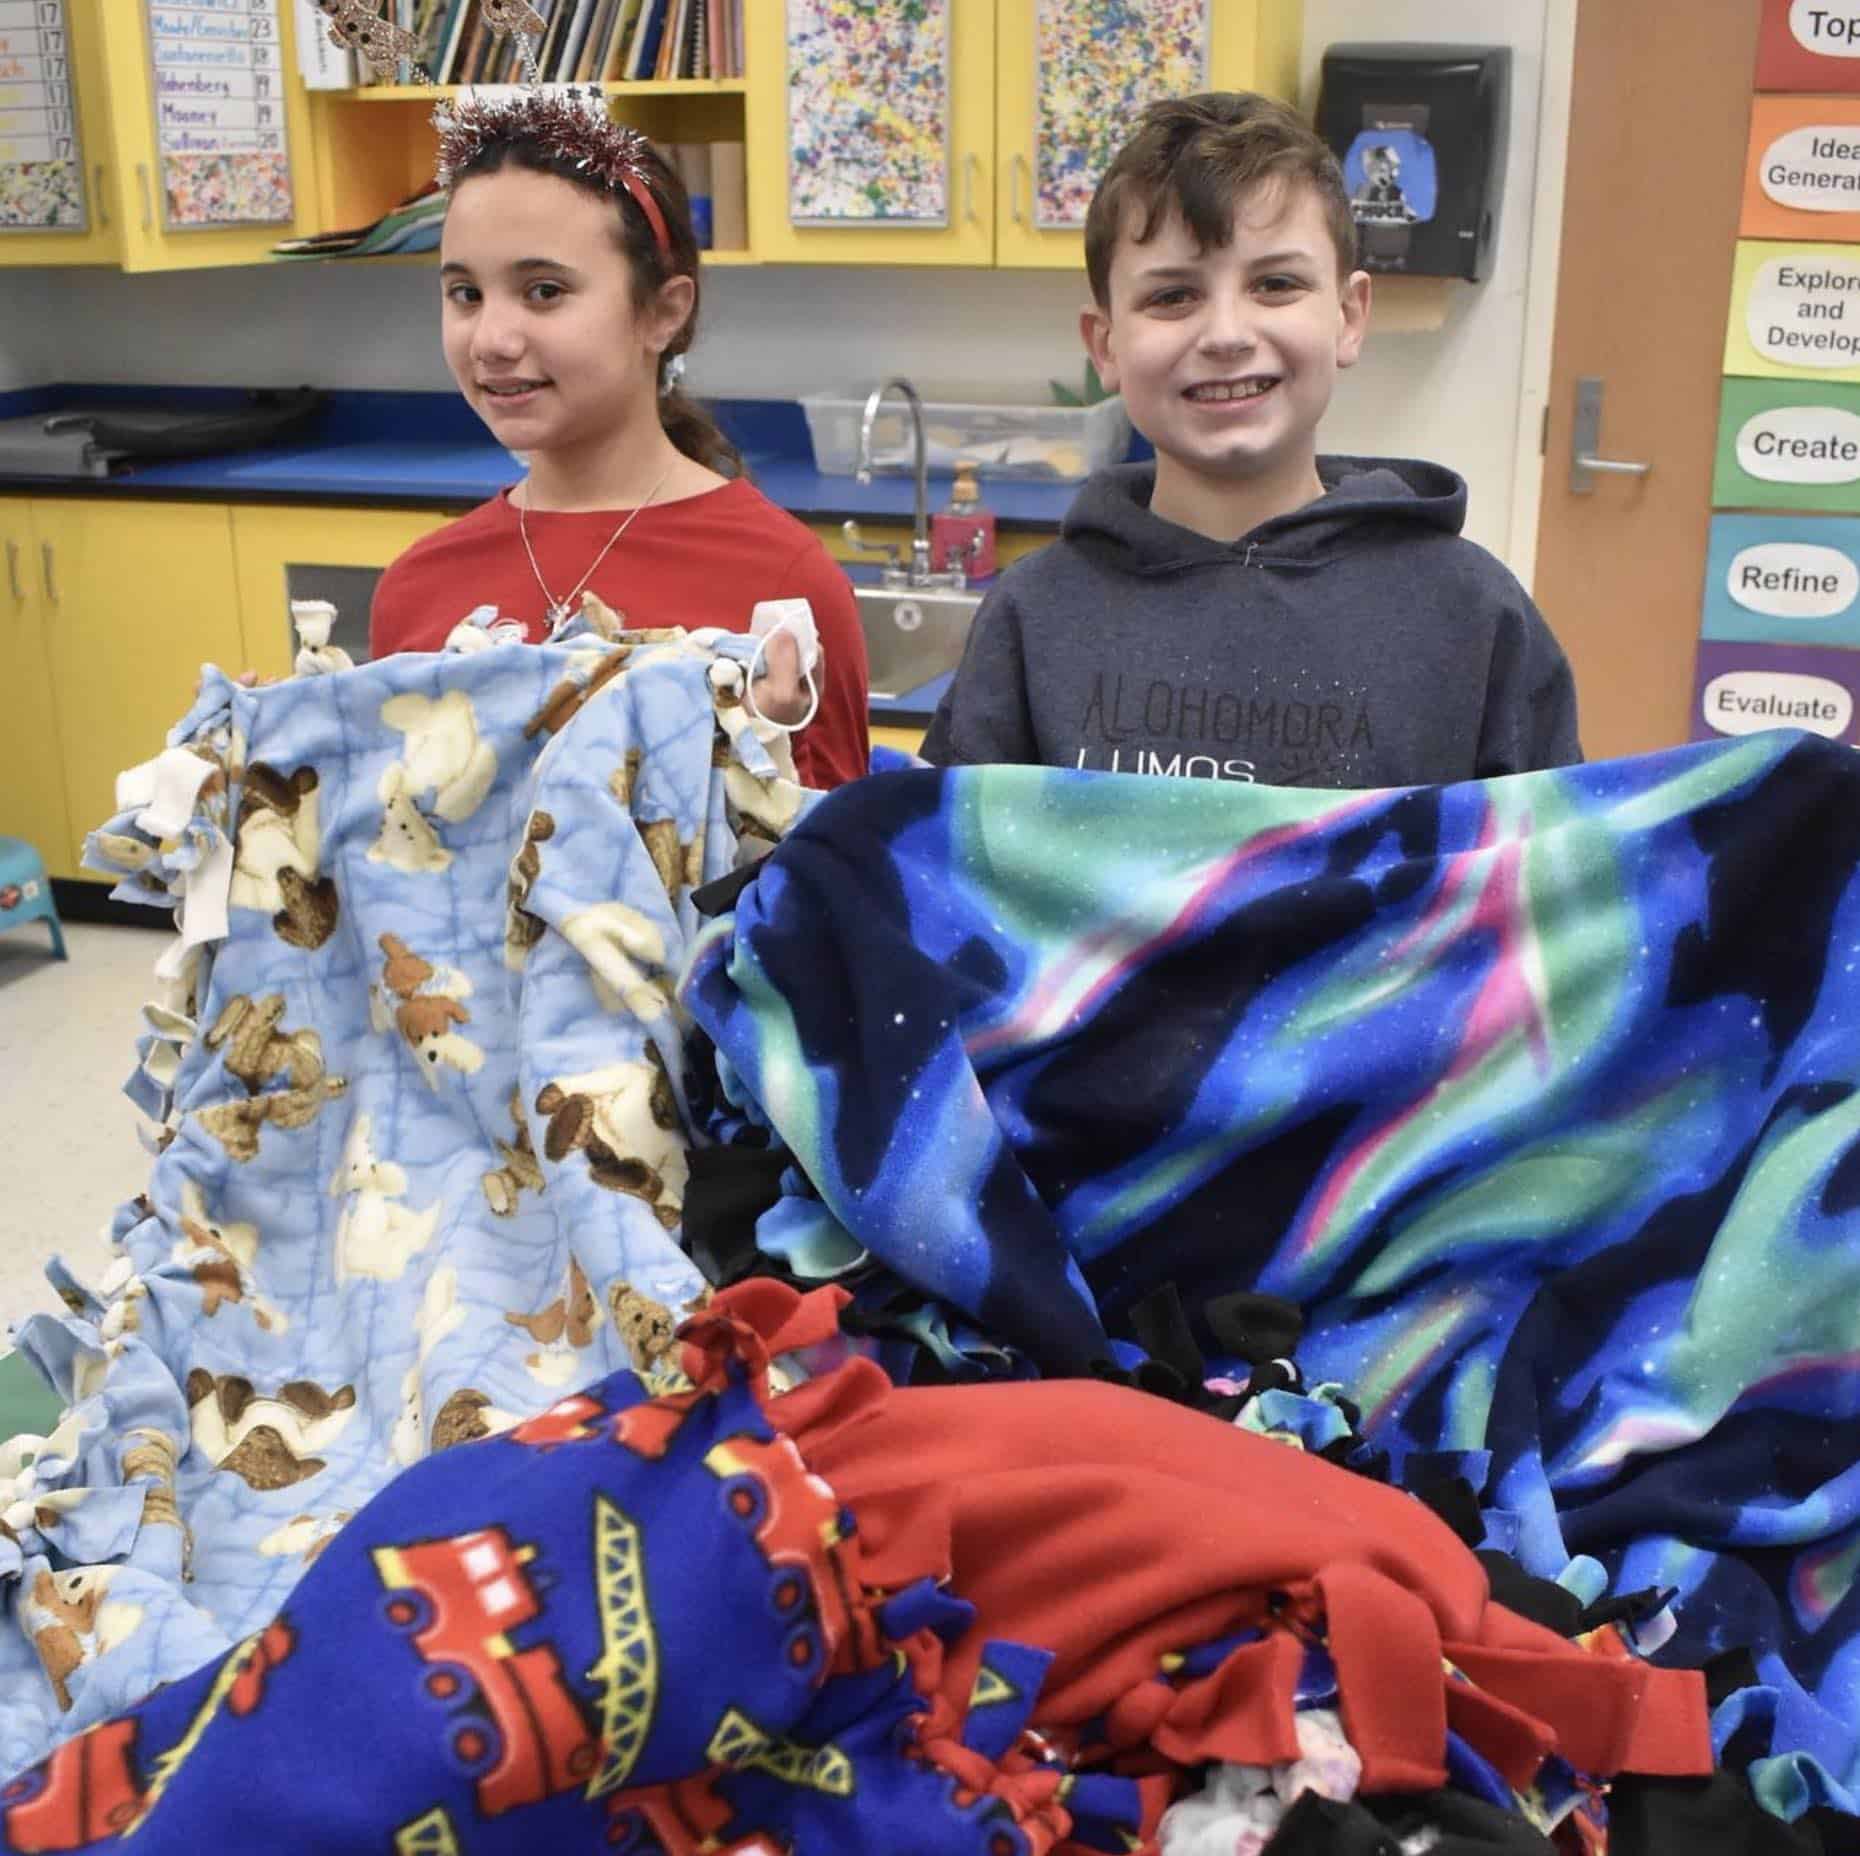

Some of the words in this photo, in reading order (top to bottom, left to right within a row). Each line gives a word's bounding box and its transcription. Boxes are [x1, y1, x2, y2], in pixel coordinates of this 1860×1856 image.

[40, 3, 57, 23] 17
[44, 31, 61, 51] 17
[47, 58, 64, 77] 17
[1778, 266, 1860, 293] Explor
[1797, 300, 1844, 320] and
[1753, 431, 1858, 461] Create
[1741, 565, 1839, 593] Refine
[1081, 671, 1375, 750] ALOHOMORA
[1718, 690, 1838, 720] Evaluate
